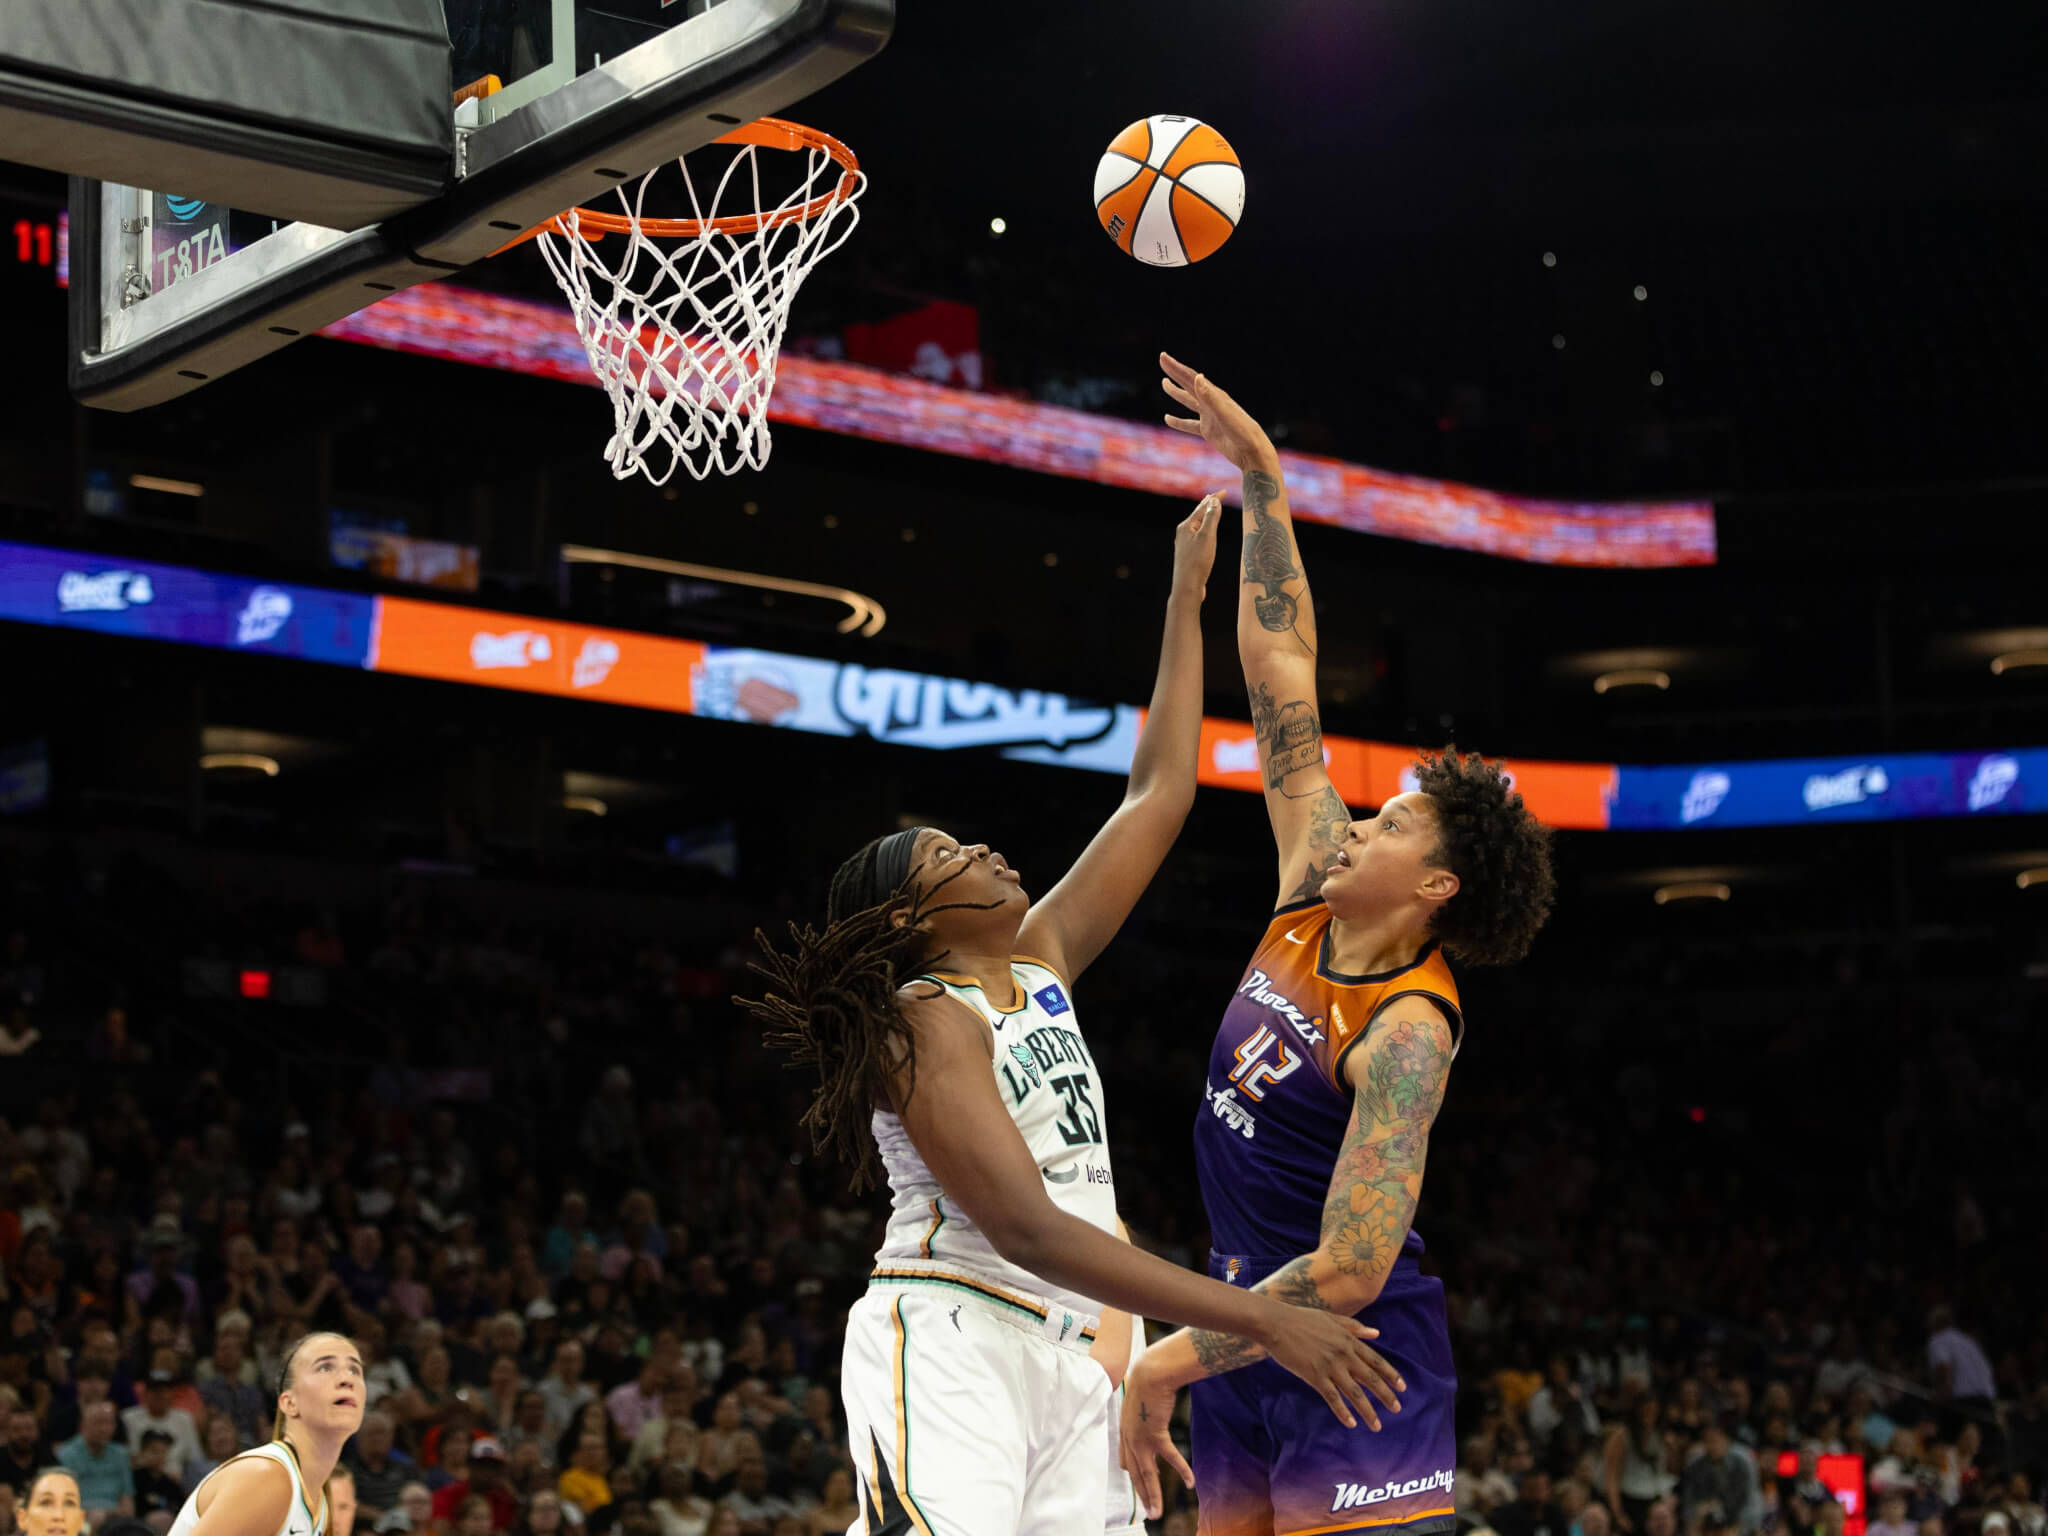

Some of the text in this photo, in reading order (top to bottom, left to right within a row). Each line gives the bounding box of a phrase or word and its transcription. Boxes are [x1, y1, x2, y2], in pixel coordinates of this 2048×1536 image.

[13, 219, 52, 266] 11
[1238, 968, 1326, 1046] Phoenix
[1228, 1023, 1302, 1101] 42
[1049, 1073, 1102, 1146] 35
[1213, 1088, 1255, 1138] fry's
[1331, 1469, 1455, 1512] Mercury
